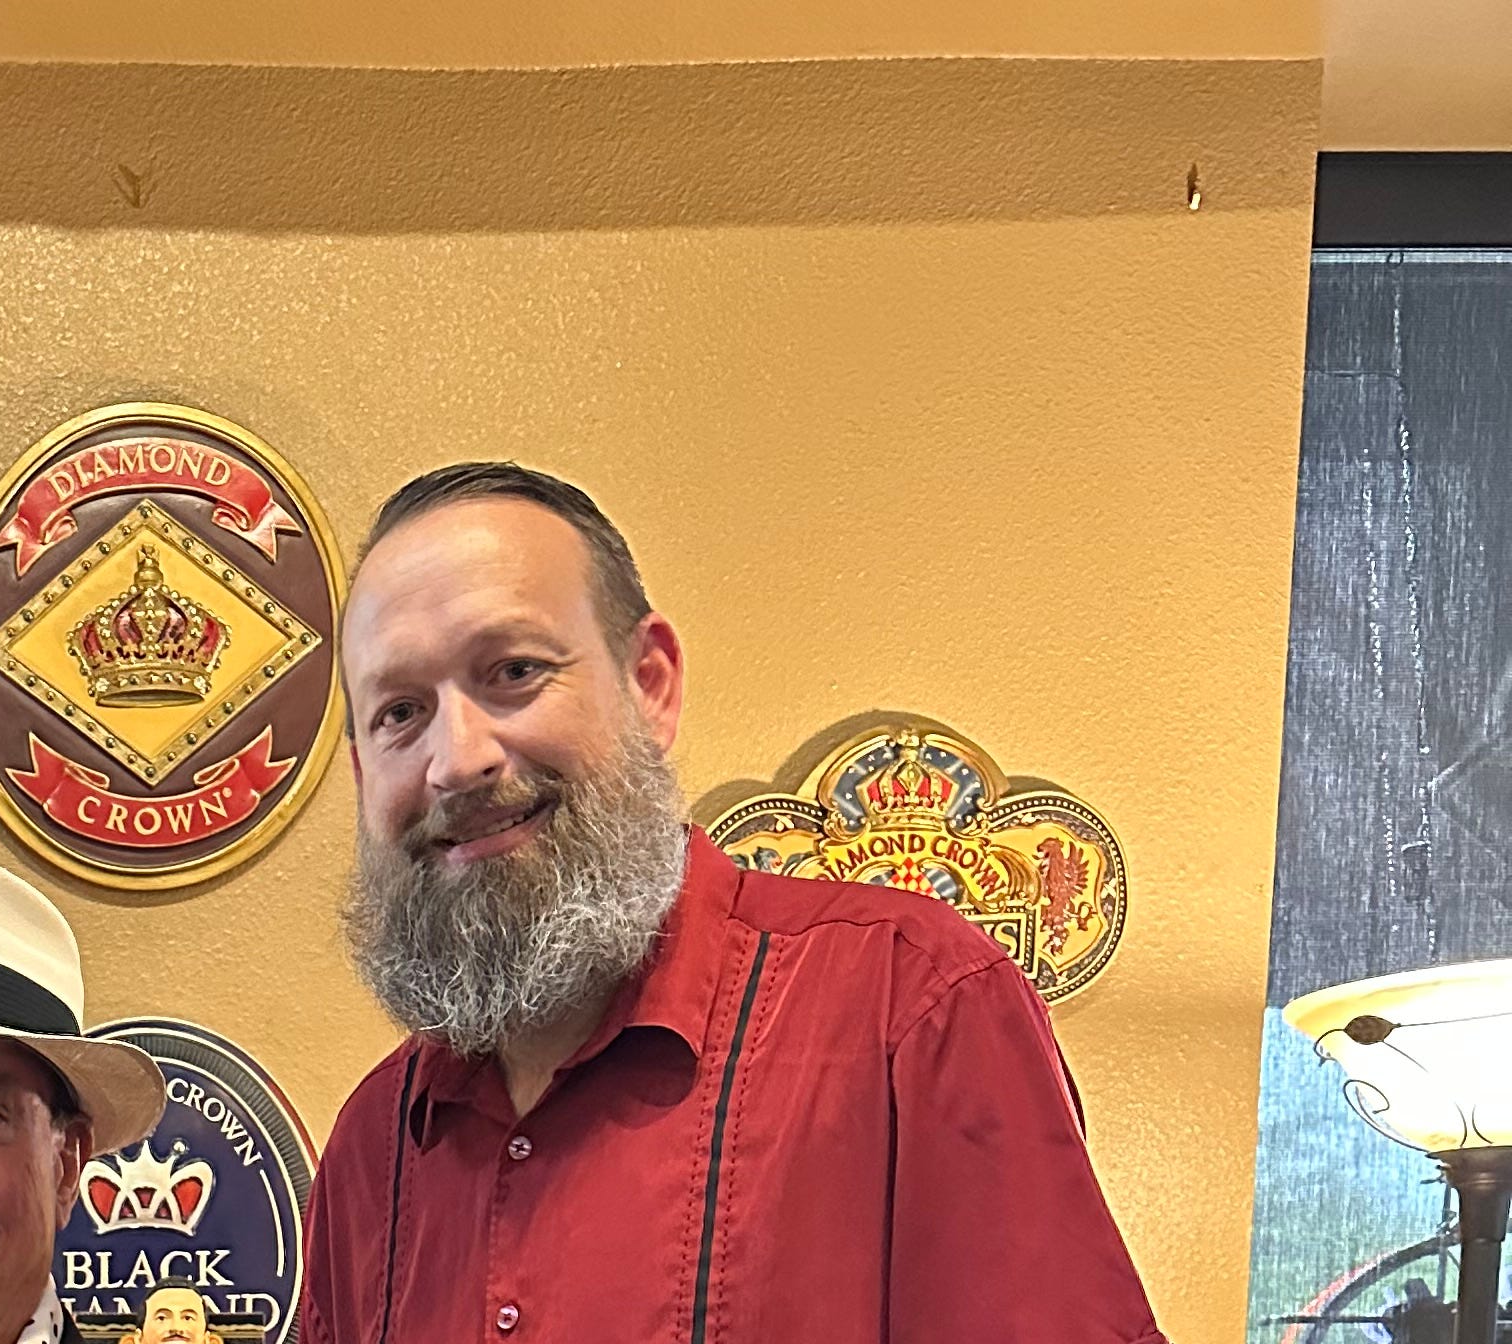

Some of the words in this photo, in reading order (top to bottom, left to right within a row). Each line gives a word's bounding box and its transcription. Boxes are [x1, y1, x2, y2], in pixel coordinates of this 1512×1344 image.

[47, 443, 232, 503] DIAMOND
[816, 833, 926, 881] IAMOND
[930, 835, 1007, 899] CROWN
[166, 1077, 263, 1167] CROWN
[62, 1249, 235, 1289] BLACK
